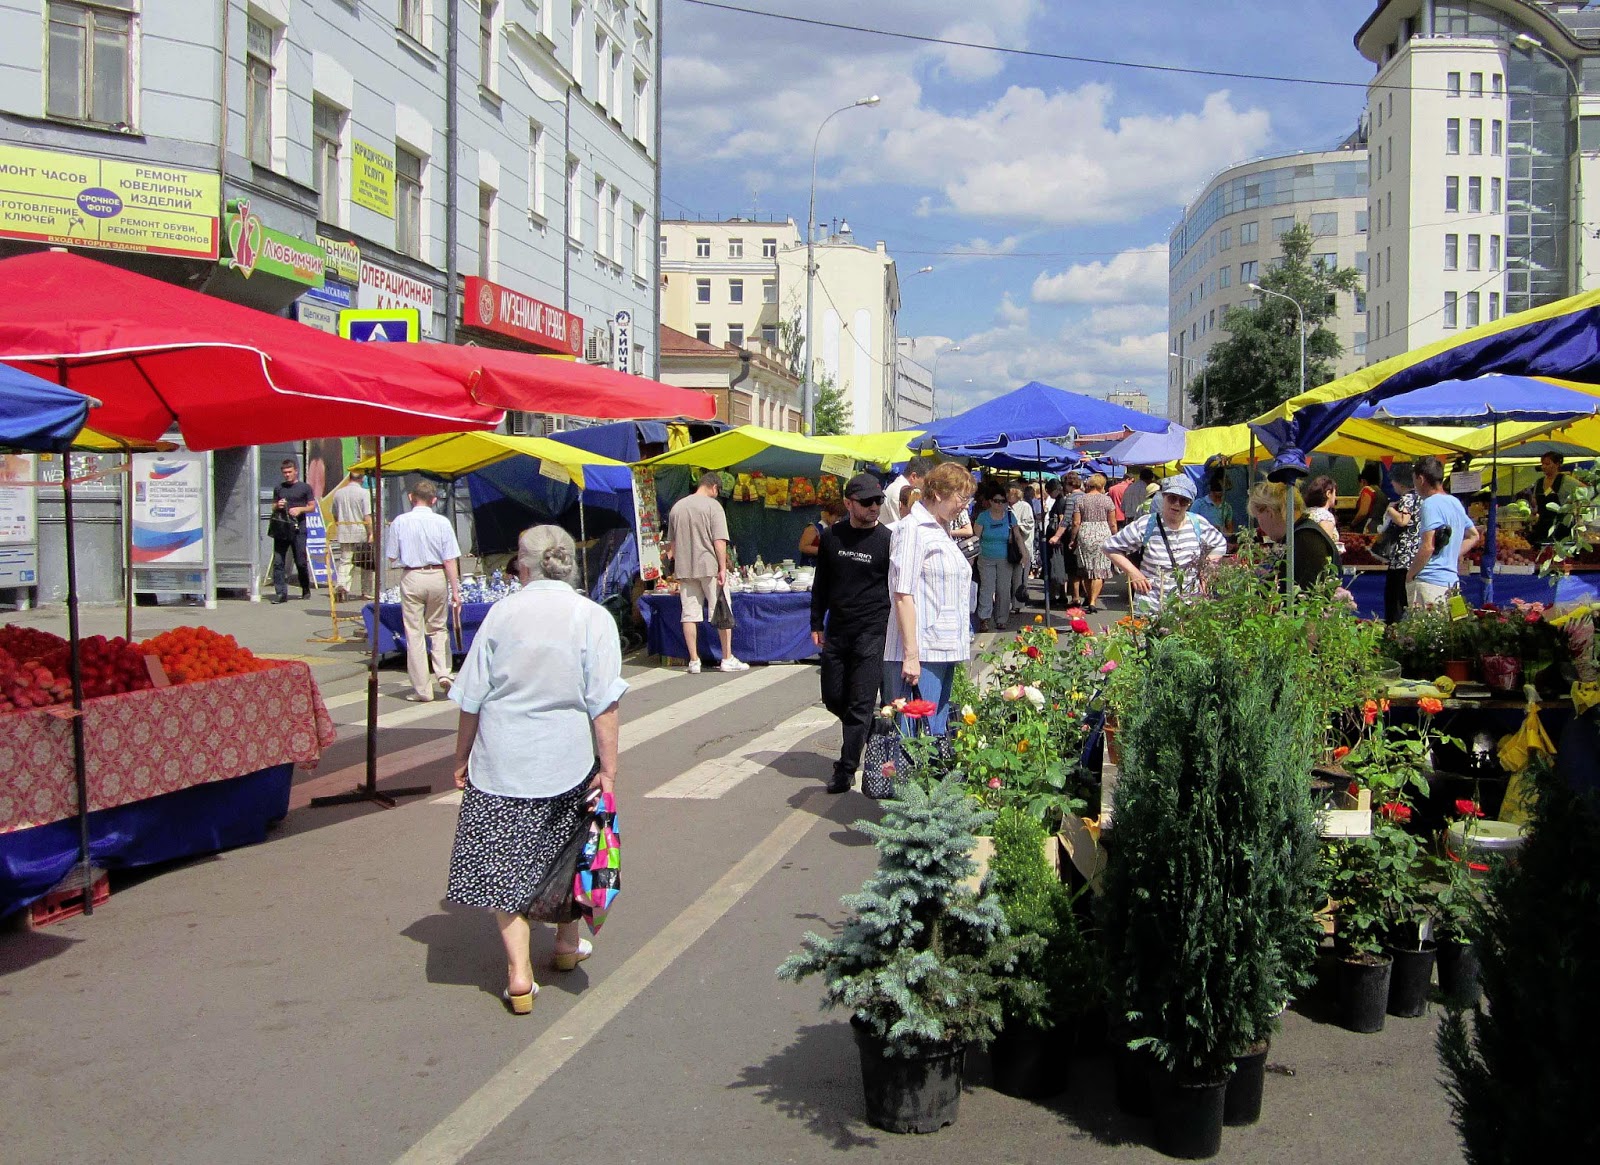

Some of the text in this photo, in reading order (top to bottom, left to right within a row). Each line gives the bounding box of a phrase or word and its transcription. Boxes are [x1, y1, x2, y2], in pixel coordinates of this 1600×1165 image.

[0, 164, 87, 184] МОНТ ЧАСОВ
[135, 168, 188, 184] РЕМОНТ
[363, 163, 385, 183] УСЛУГИ
[119, 179, 203, 198] ЮВЕЛИРНЫХ
[0, 199, 79, 217] ГОТОВЛЕНИЕ
[79, 194, 120, 207] СРОЧНОЕ
[86, 203, 113, 213] ФОТО
[130, 193, 193, 210] ИЗДЕЛИЙ
[4, 212, 55, 226] КЛЮЧЕЙ
[120, 217, 161, 231] РЕМОНТ
[47, 235, 74, 246] ВХОД
[82, 239, 112, 250] ТОРЦА
[112, 243, 148, 253] ЗДАНИЯ
[107, 225, 210, 245] РЕМОНТ ТЕЛЕФОНОВ
[264, 238, 323, 274] ЛЮБИМЧИК
[316, 238, 358, 264] ЛЬНИКИ
[361, 263, 433, 306] ОПЕРАЦИОННАЯ
[618, 328, 628, 374] ХИМЧИ
[305, 516, 323, 529] АССА
[837, 550, 872, 560] EMPORIO
